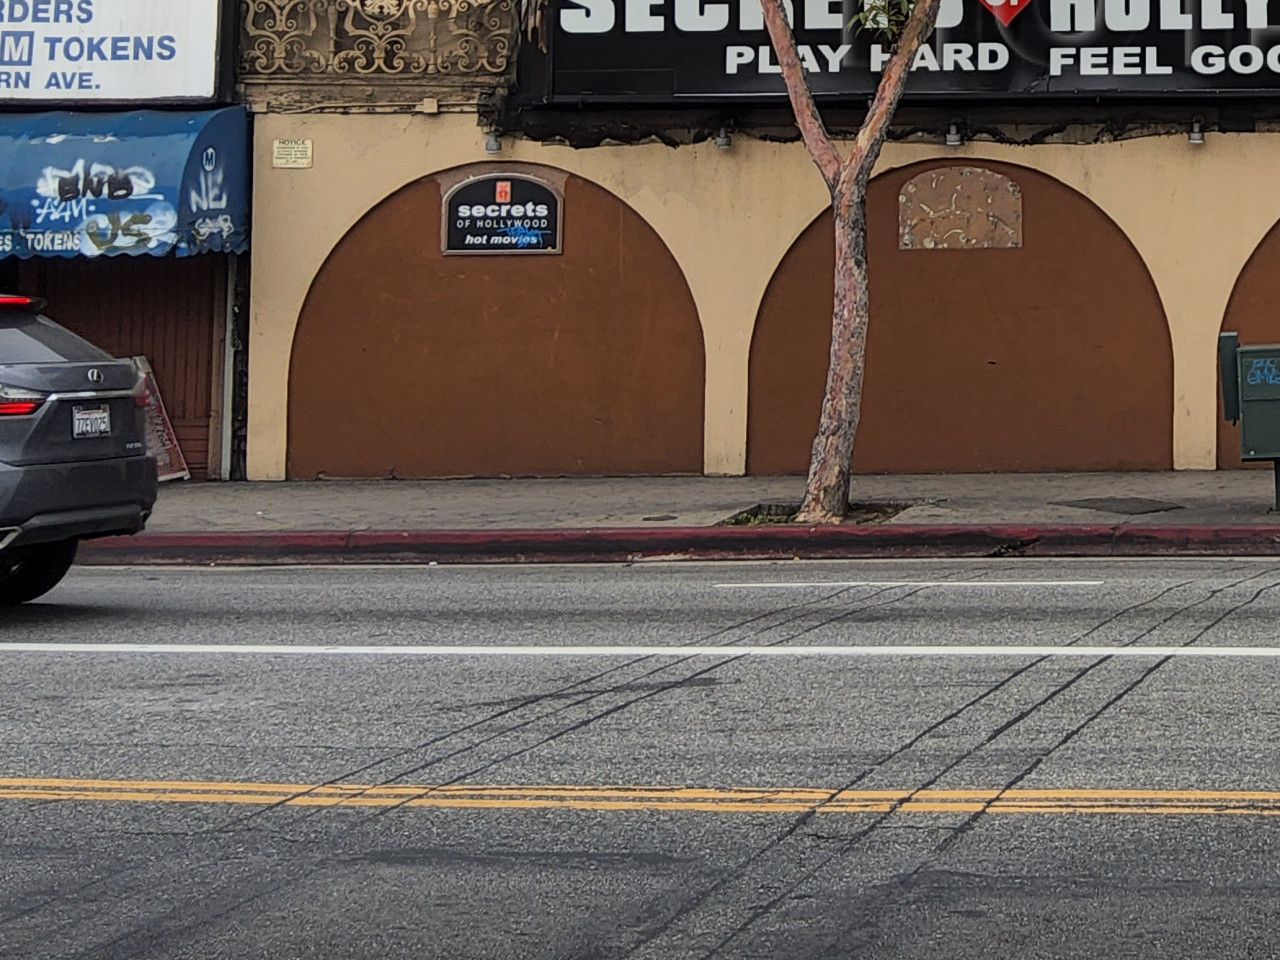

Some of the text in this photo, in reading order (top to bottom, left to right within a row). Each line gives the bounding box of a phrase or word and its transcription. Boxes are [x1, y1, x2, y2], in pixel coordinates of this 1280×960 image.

[43, 35, 176, 62] TOKENS
[726, 44, 851, 74] PLAY
[1050, 46, 1173, 76] FEEL
[45, 71, 101, 90] AVE.
[458, 201, 549, 217] secrets
[456, 219, 549, 229] OF HOLLYWOOD
[0, 232, 81, 252] S TOKENS
[465, 234, 488, 245] hot
[490, 235, 538, 245] movies
